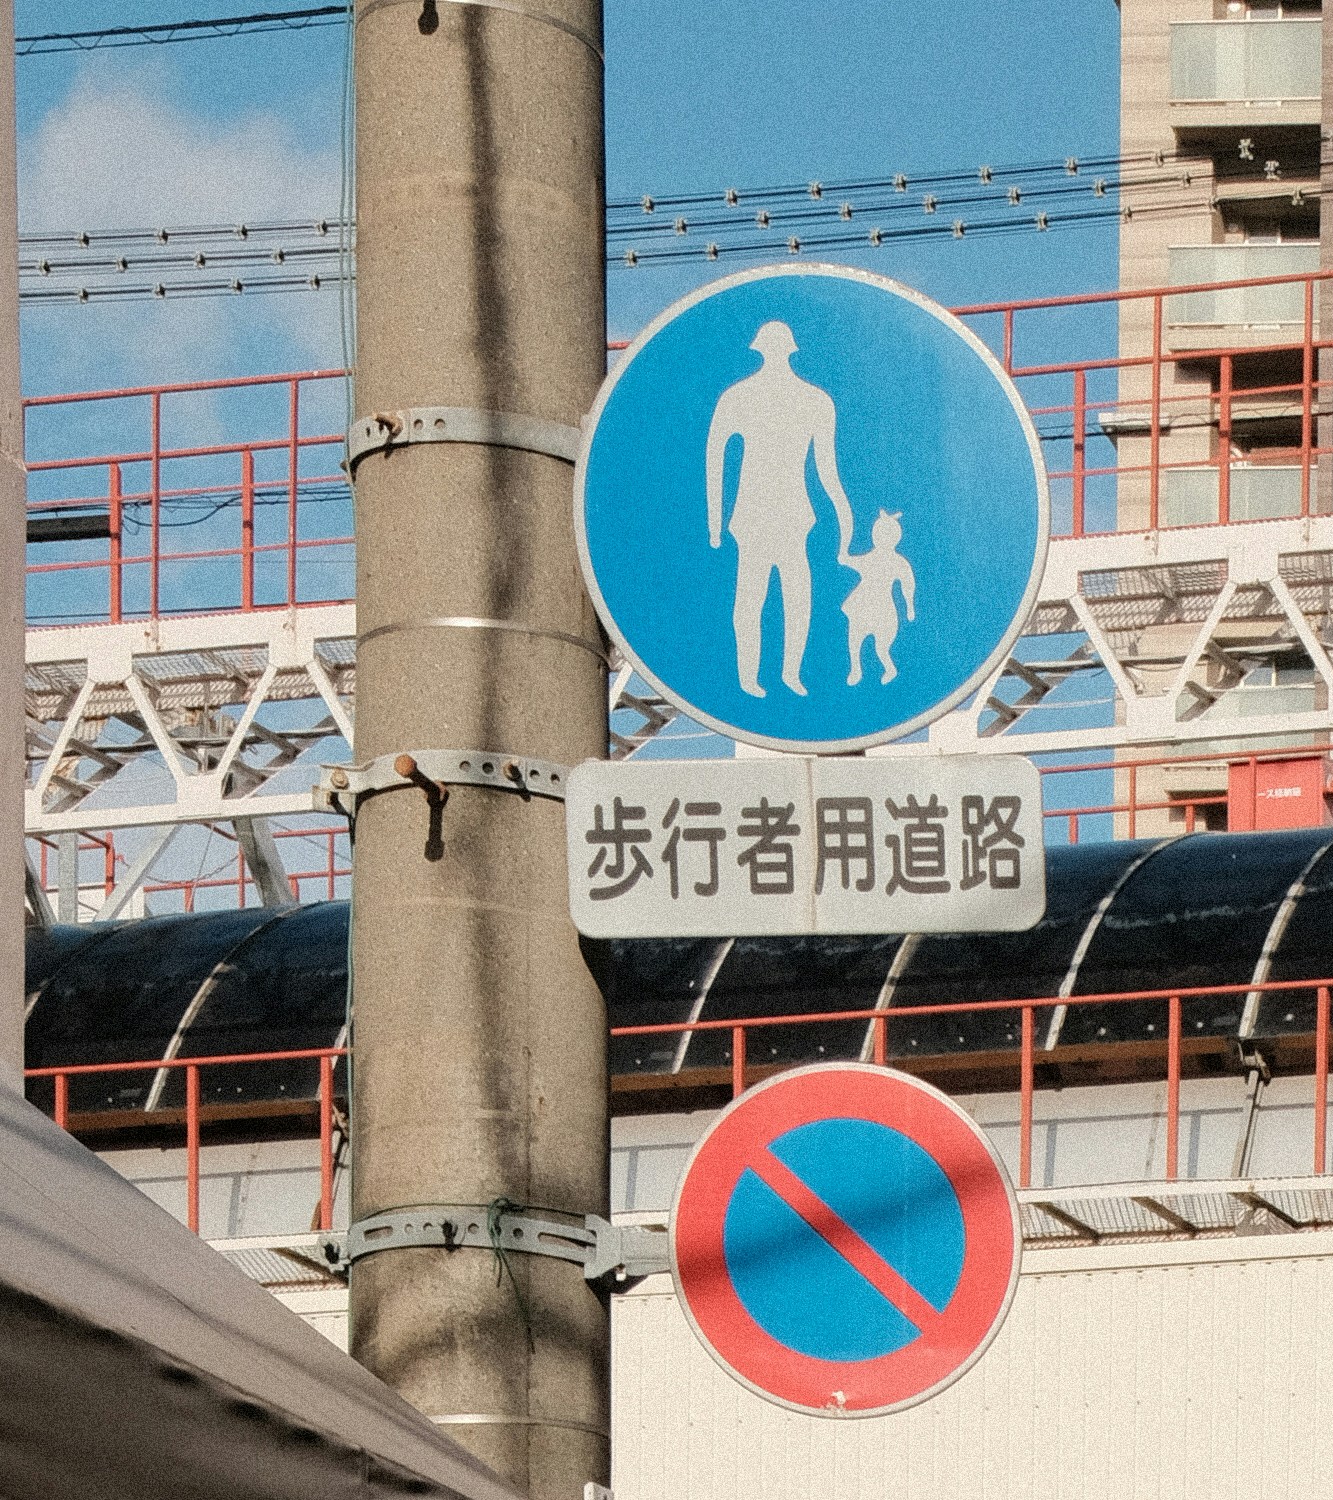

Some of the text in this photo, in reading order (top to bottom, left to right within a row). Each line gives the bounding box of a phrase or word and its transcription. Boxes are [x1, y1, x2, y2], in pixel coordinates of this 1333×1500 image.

[585, 793, 1026, 901] 歩行者用道路
